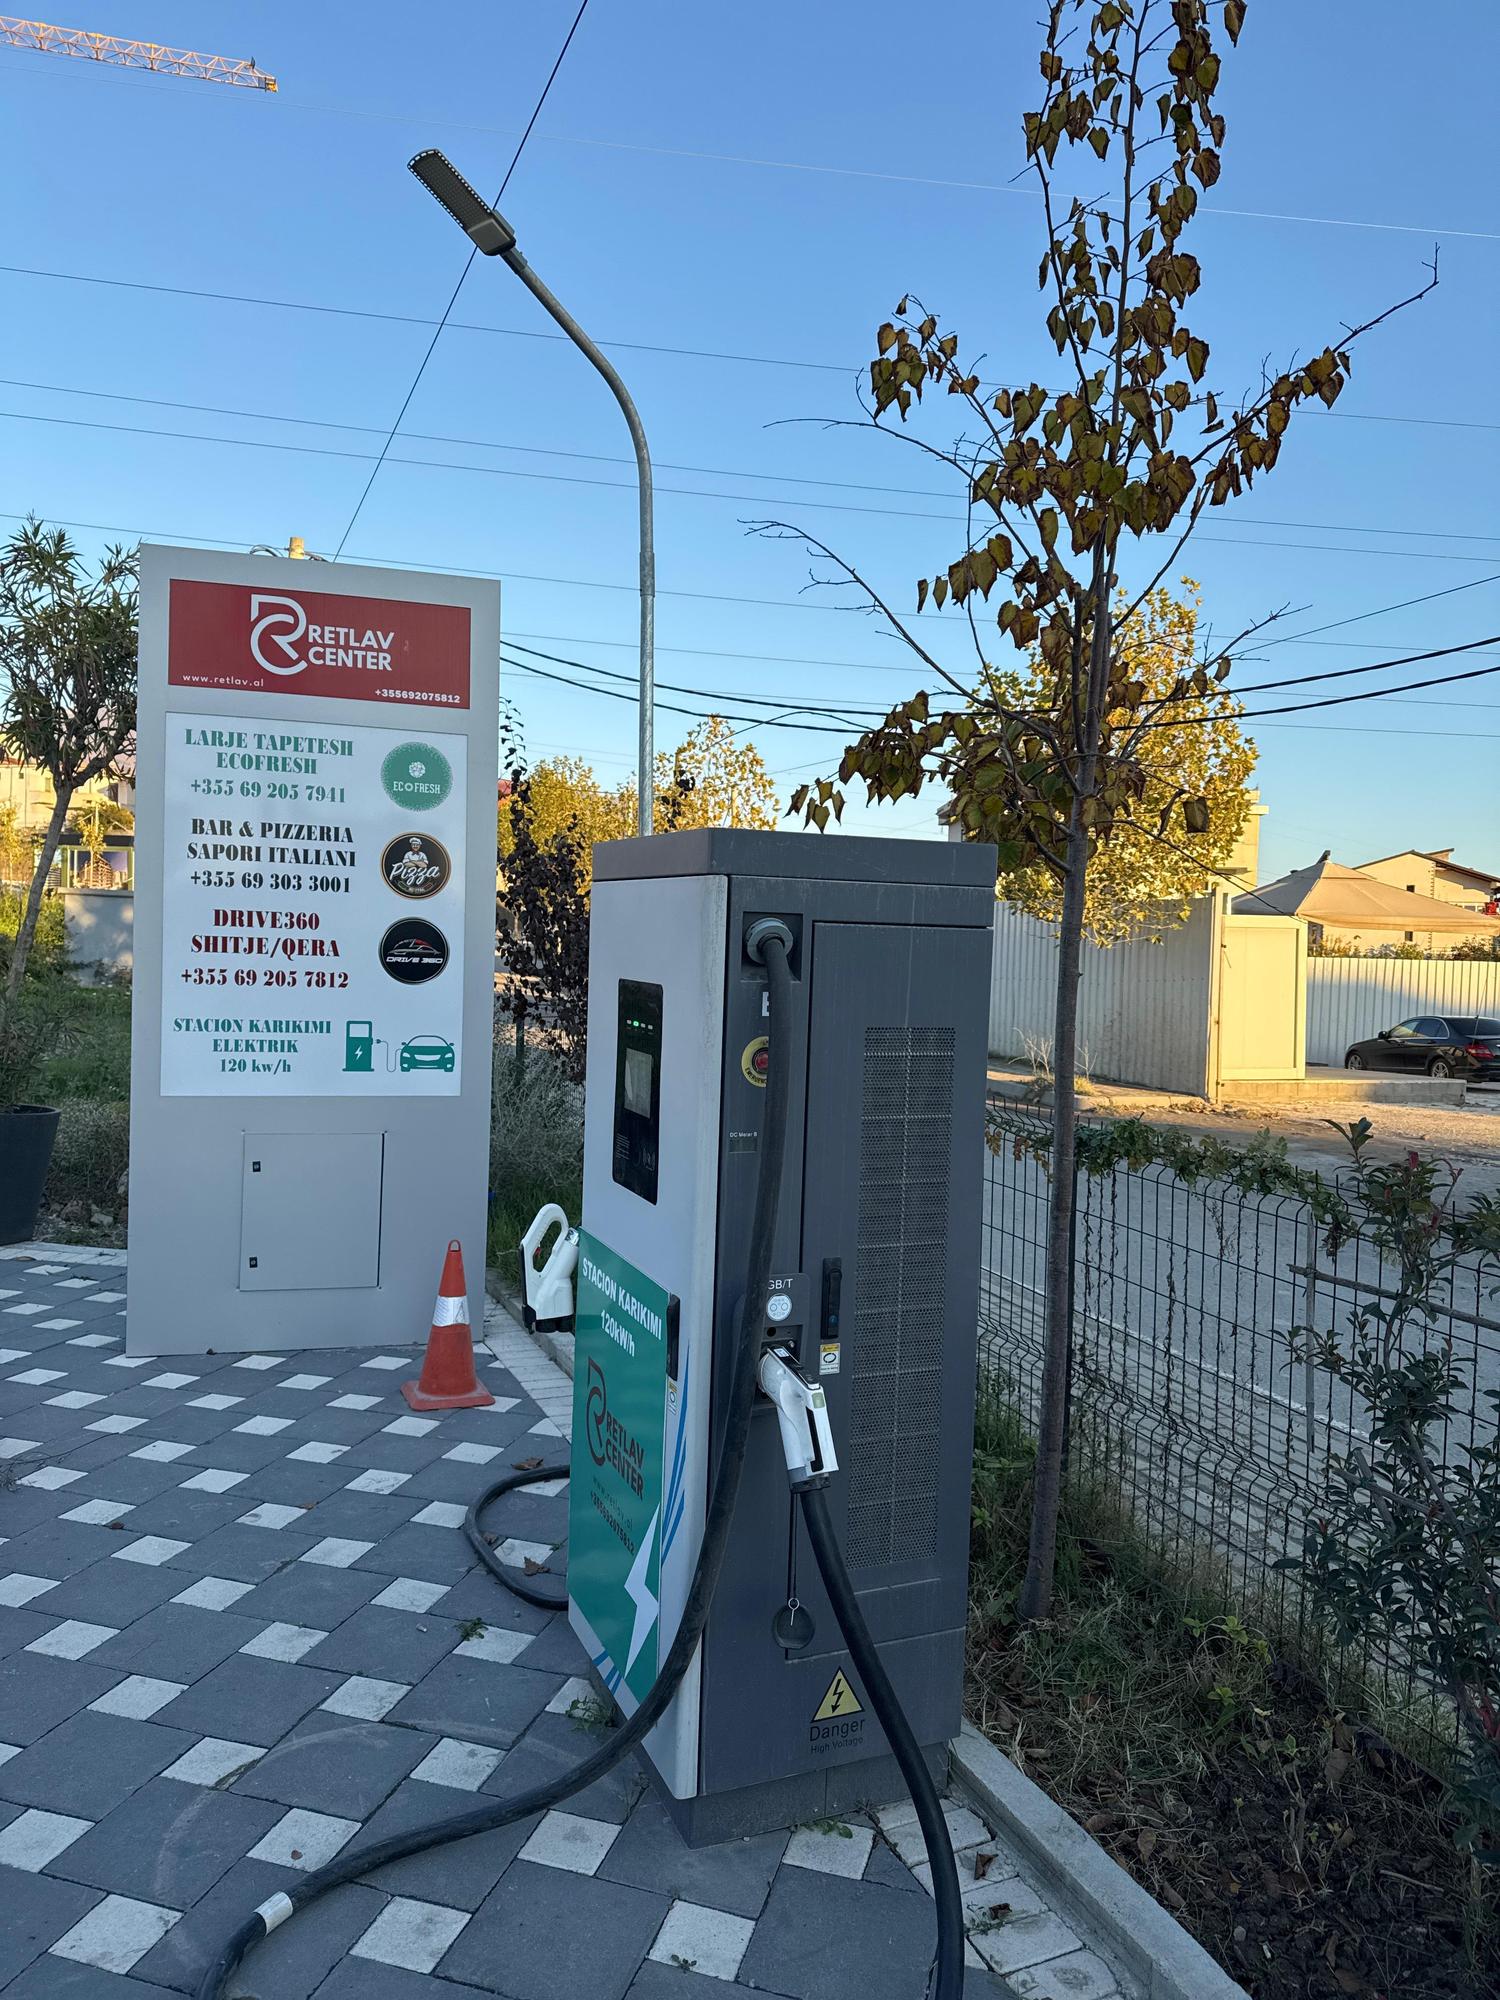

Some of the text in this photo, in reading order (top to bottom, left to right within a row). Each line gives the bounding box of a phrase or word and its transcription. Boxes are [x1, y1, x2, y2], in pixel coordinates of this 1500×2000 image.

[308, 624, 394, 649] RETLAV
[308, 646, 392, 671] CENTER
[182, 674, 264, 687] www.retlav.al
[375, 689, 461, 704] +355692075812
[185, 729, 353, 756] LARJE TAPETESH
[217, 752, 317, 774] ECOFRESH
[191, 778, 345, 802] +355 69 205 7941
[191, 818, 353, 843] BAR & PIZZERIA
[187, 842, 356, 867] SAPORI ITALIANI
[191, 870, 350, 893] +355 69 303 3001
[389, 862, 440, 886] Pizza
[212, 909, 320, 930] DRIVE360
[191, 935, 340, 961] SHITJE/QERA
[181, 968, 349, 988] +355 69 205 7812
[173, 1018, 331, 1034] STACION KARIKIMI
[212, 1039, 298, 1053] ELEKTRIK
[221, 1058, 291, 1075] 120 kw/h
[583, 1258, 662, 1340] STACION KARIKIMI
[601, 1310, 635, 1357] 120kW/h
[605, 1410, 644, 1470] RETLAV
[605, 1439, 644, 1500] CENTER
[809, 1719, 865, 1741] Danger
[810, 1736, 864, 1754] High Voltage
